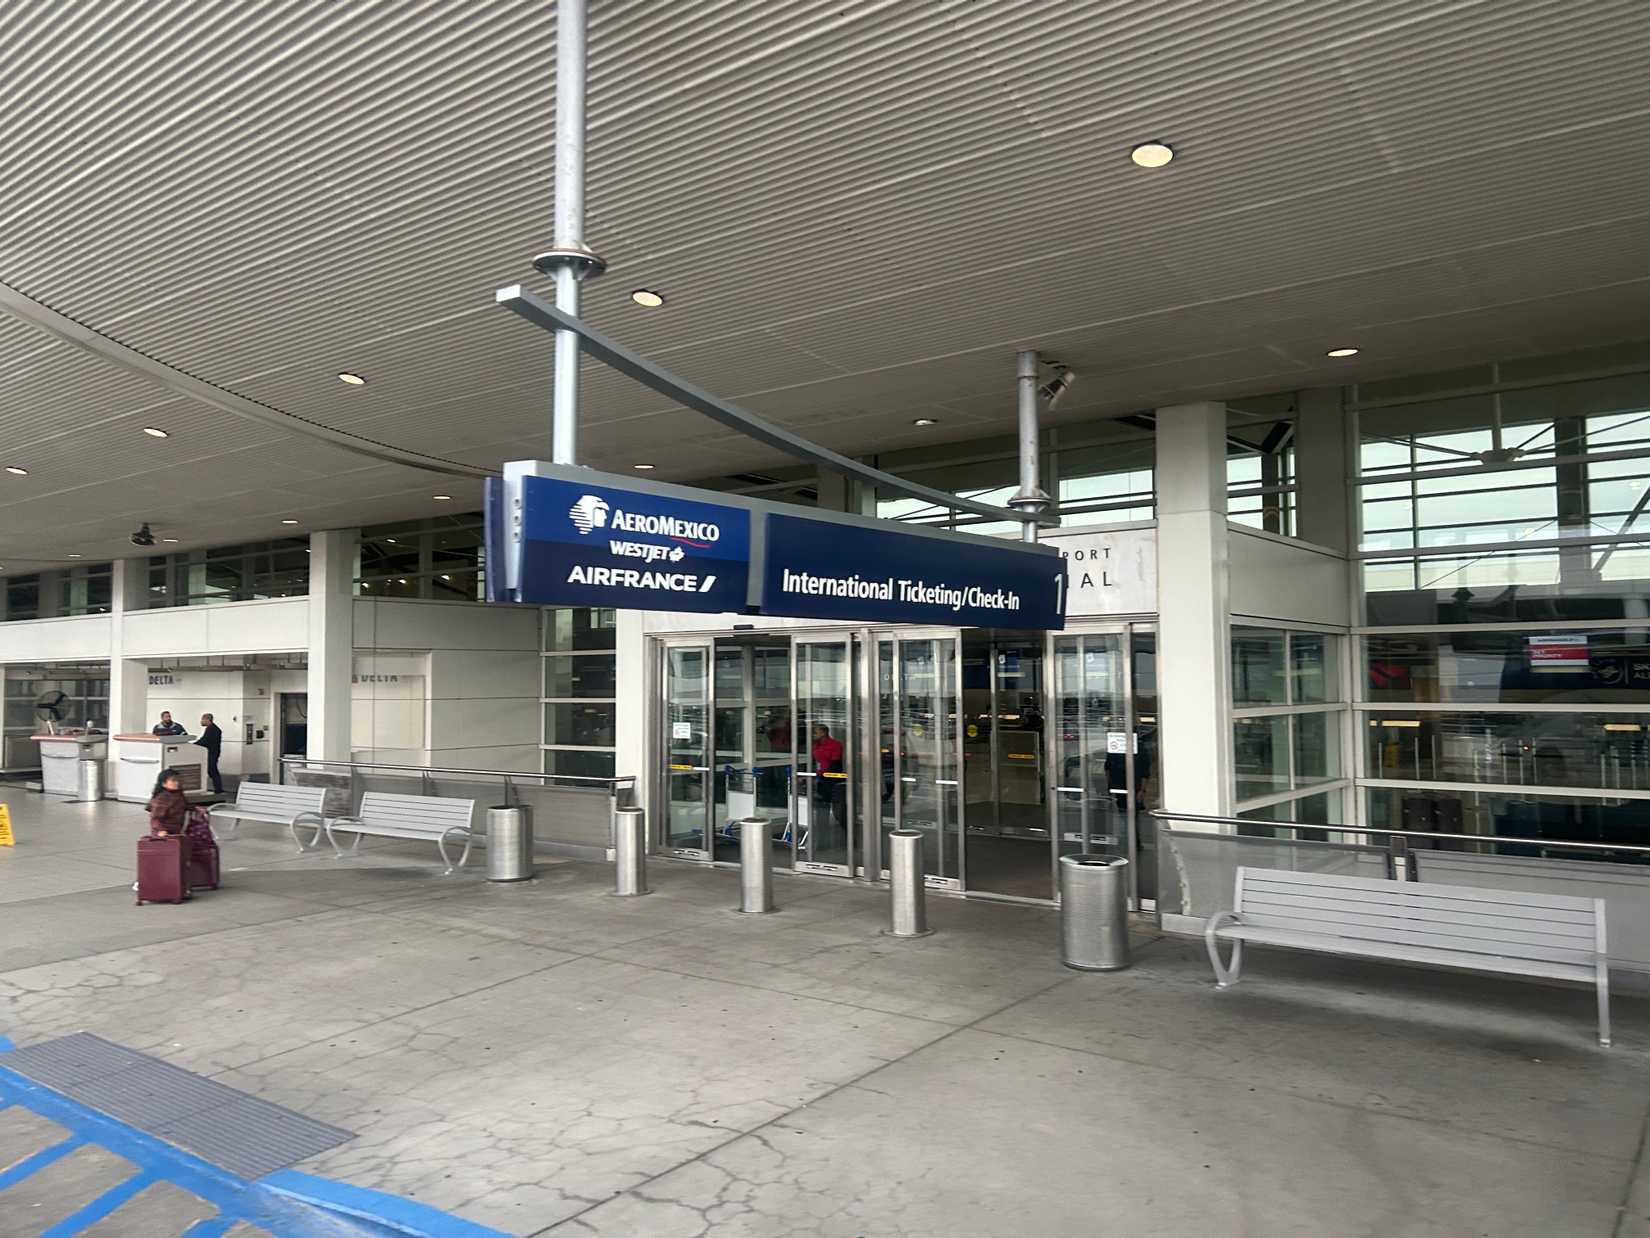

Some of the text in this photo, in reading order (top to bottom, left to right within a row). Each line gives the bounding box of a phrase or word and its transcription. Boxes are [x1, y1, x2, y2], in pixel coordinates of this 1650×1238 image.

[568, 565, 697, 592] AIRFRANCE
[782, 568, 1020, 611] International Ticketing/Check-In
[1054, 573, 1063, 615] 1
[1066, 571, 1112, 589] AL
